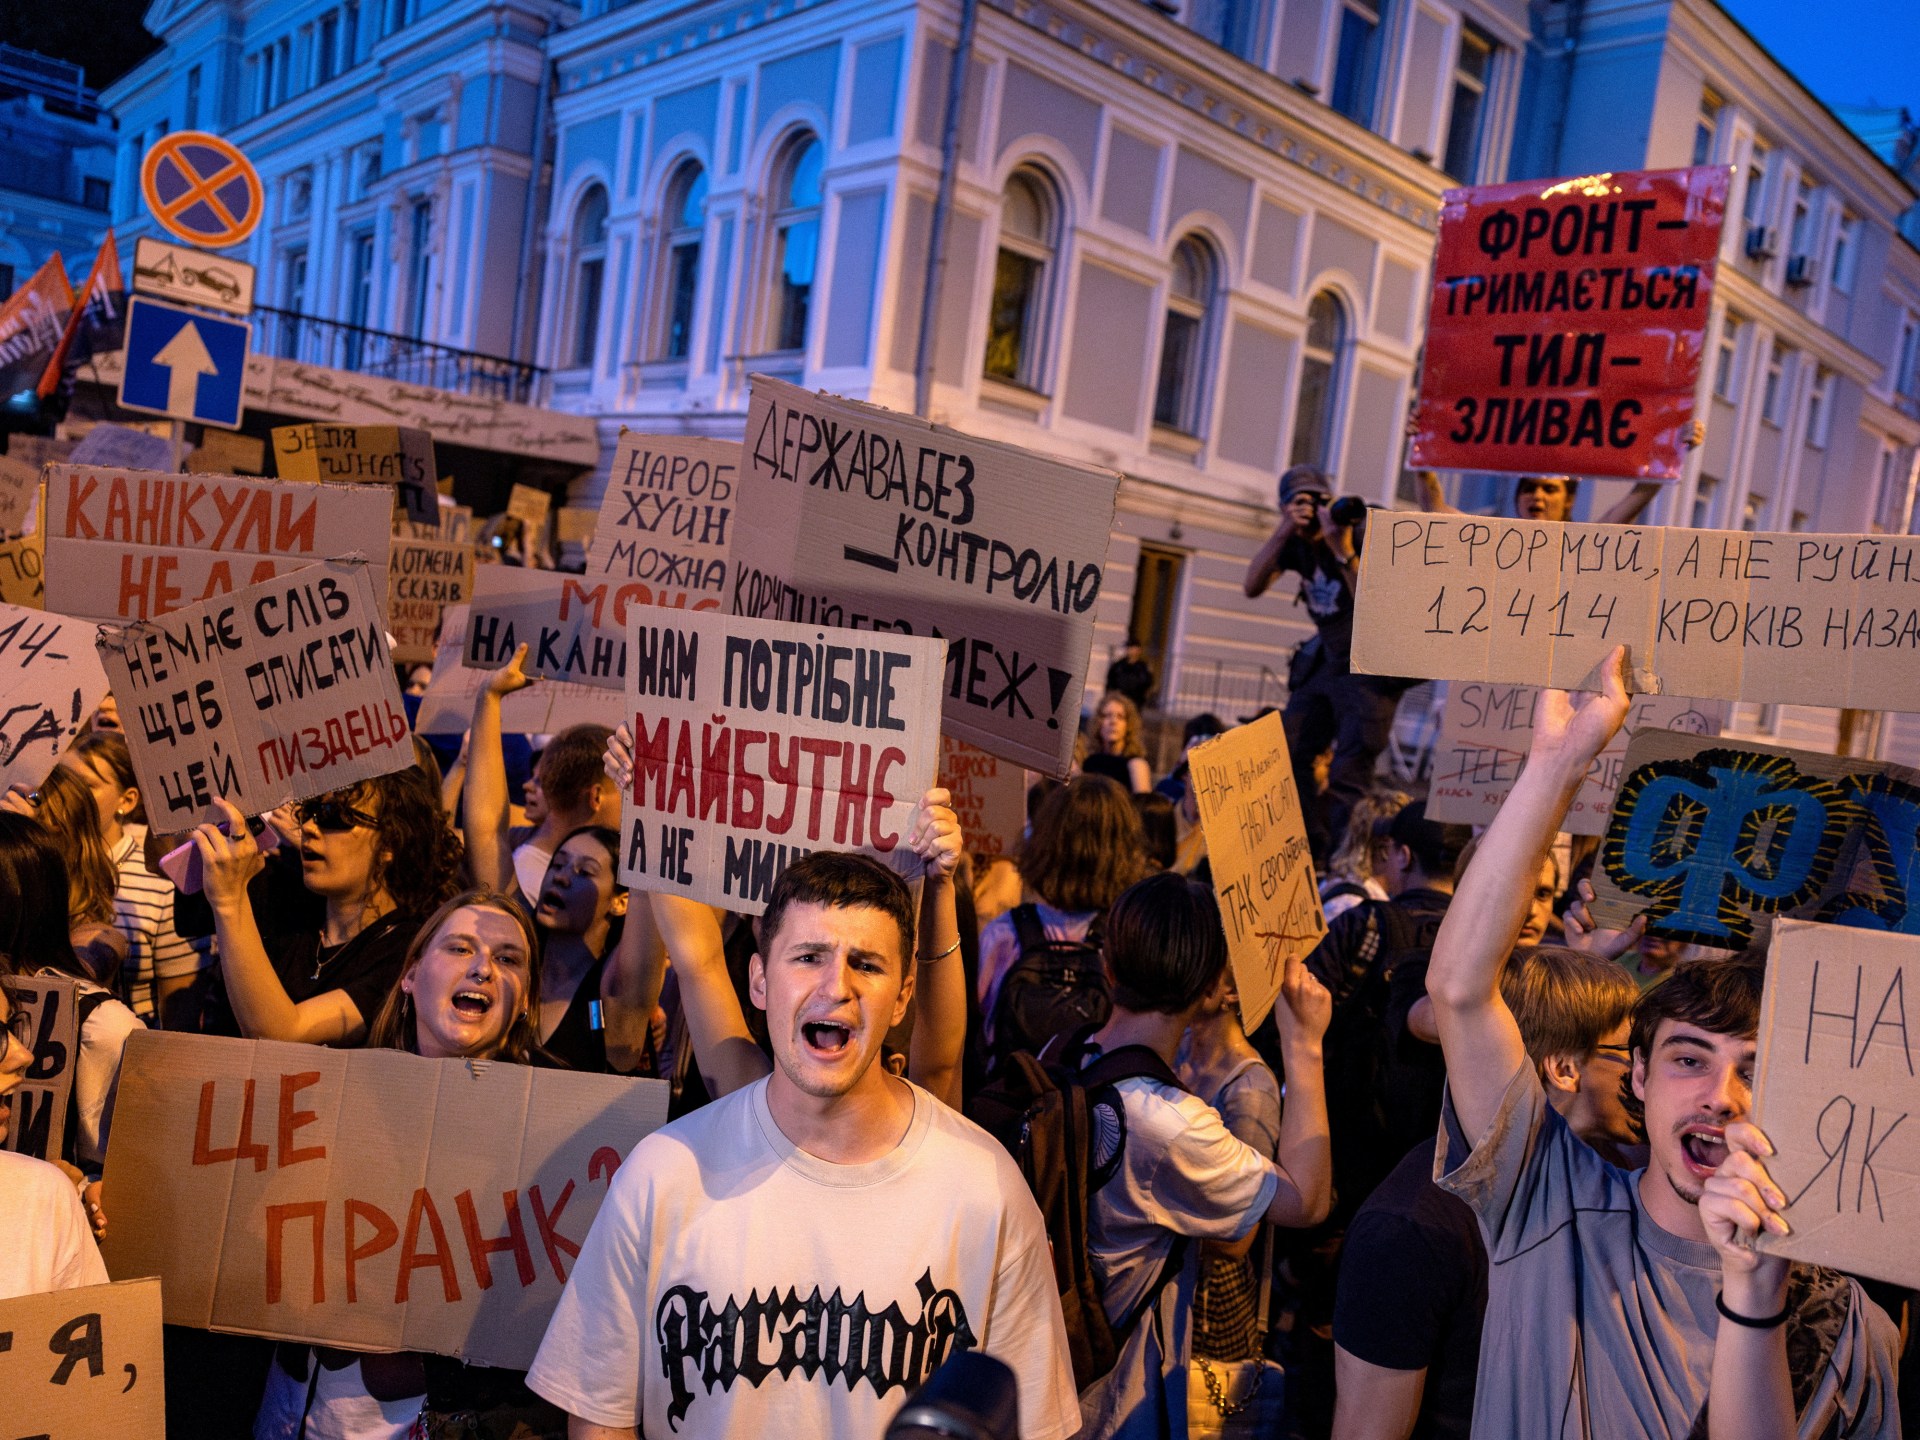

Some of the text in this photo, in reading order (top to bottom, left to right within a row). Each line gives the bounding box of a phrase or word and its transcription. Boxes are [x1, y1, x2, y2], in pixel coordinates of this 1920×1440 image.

[1445, 265, 1699, 315] ТРИМАЄТЬСЯ
[753, 401, 975, 526] ДЕРЖАВА БЕЗ
[1450, 397, 1643, 449] ЗЛИВАЄ
[66, 474, 317, 553] КАНІКУЛИ
[1391, 520, 1920, 582] РЕФОРМУЙ, А НЕ РУЙН
[118, 555, 183, 620] НЕ
[605, 540, 726, 592] МОЖНА
[895, 513, 1101, 614] КОНТРОЛЮ
[124, 578, 350, 691] НЕМАЄ СЛІВ
[471, 615, 517, 662] НА
[1425, 586, 1920, 651] 12414 КРОКІВ НАЗА
[139, 621, 384, 746] ЩОБ ОПИСАТИ
[638, 625, 911, 731] НАМ ПОТРІБНЕ
[160, 700, 407, 814] ЦЕЙ ПИЗДЕЦЬ
[633, 711, 906, 853] МАЙБУТНЄ
[628, 818, 647, 874] А
[660, 824, 695, 886] НЕ
[1220, 872, 1261, 943] ТАК
[1804, 959, 1915, 1077] НА
[192, 1071, 327, 1172] ЦЕ
[1789, 1094, 1908, 1223] ЯК
